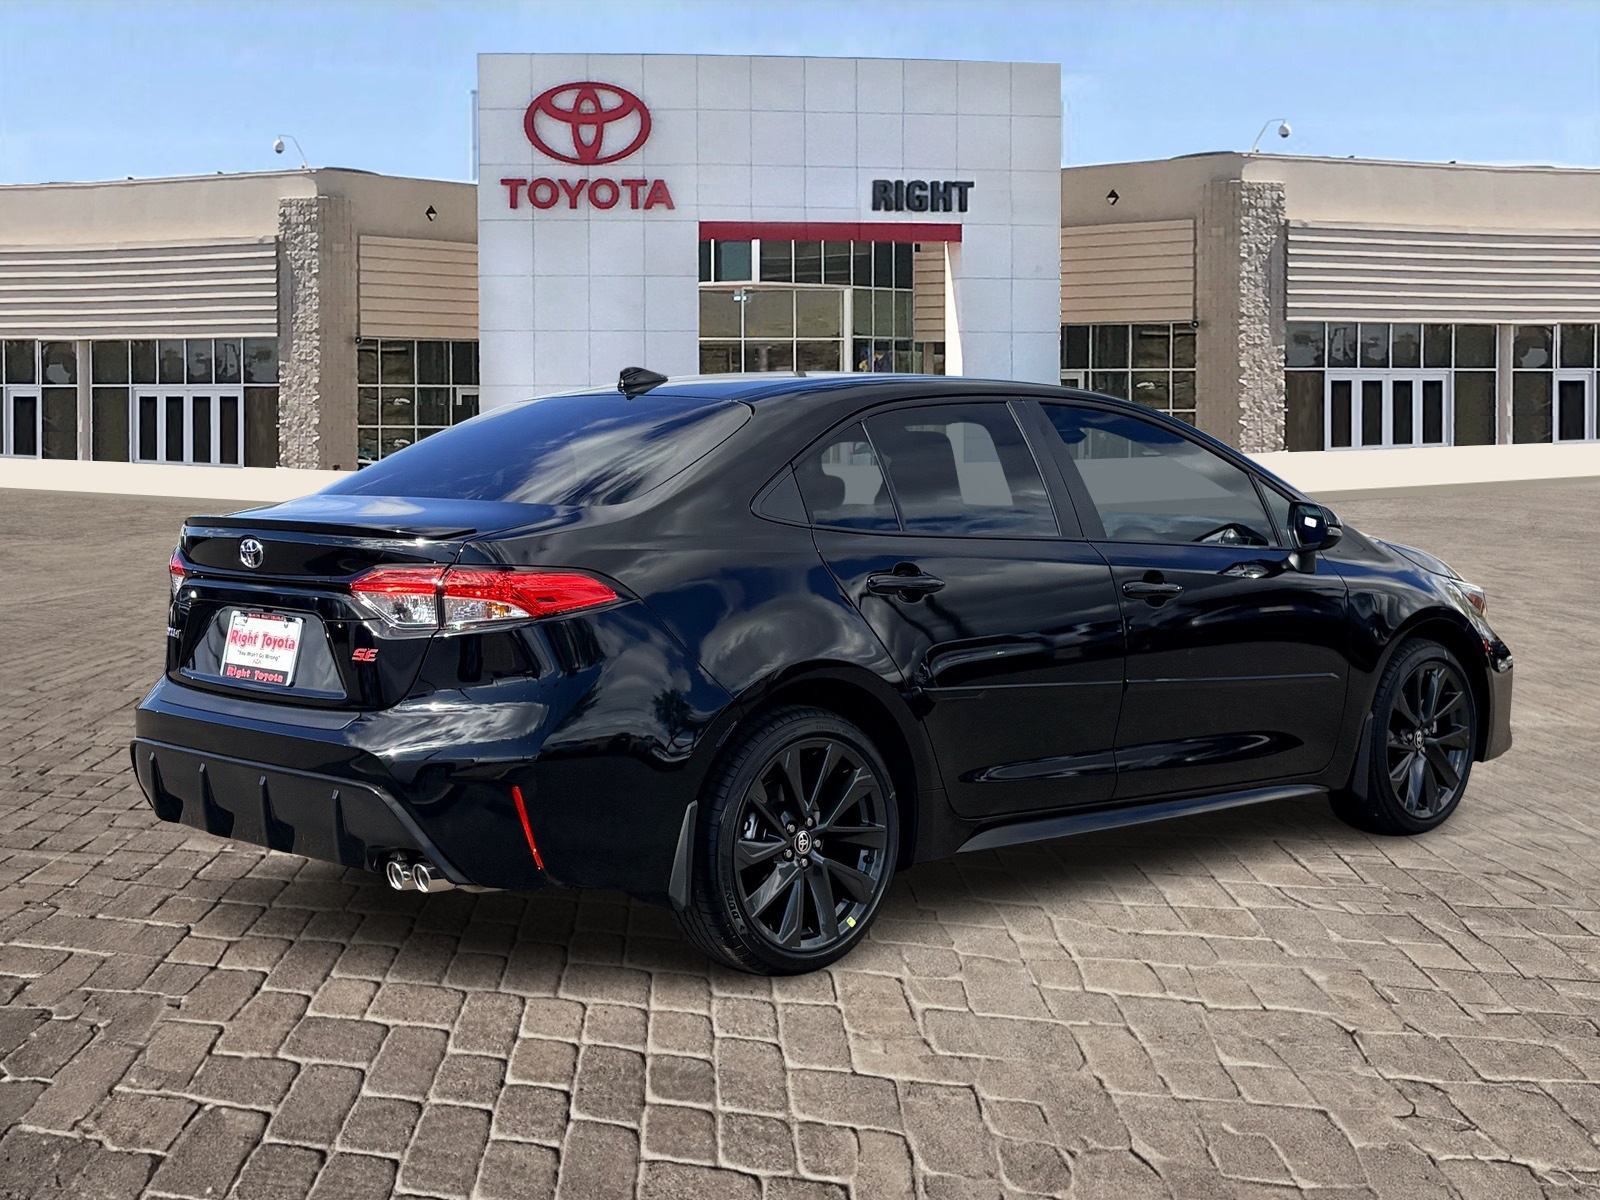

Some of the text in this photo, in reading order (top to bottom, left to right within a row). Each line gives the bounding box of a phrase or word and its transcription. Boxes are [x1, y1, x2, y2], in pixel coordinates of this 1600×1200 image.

[501, 178, 675, 210] TOYOTA
[872, 179, 975, 213] RIGHT
[230, 629, 296, 651] Right Toyota
[352, 648, 379, 662] SE
[226, 665, 283, 683] Right Toyota
